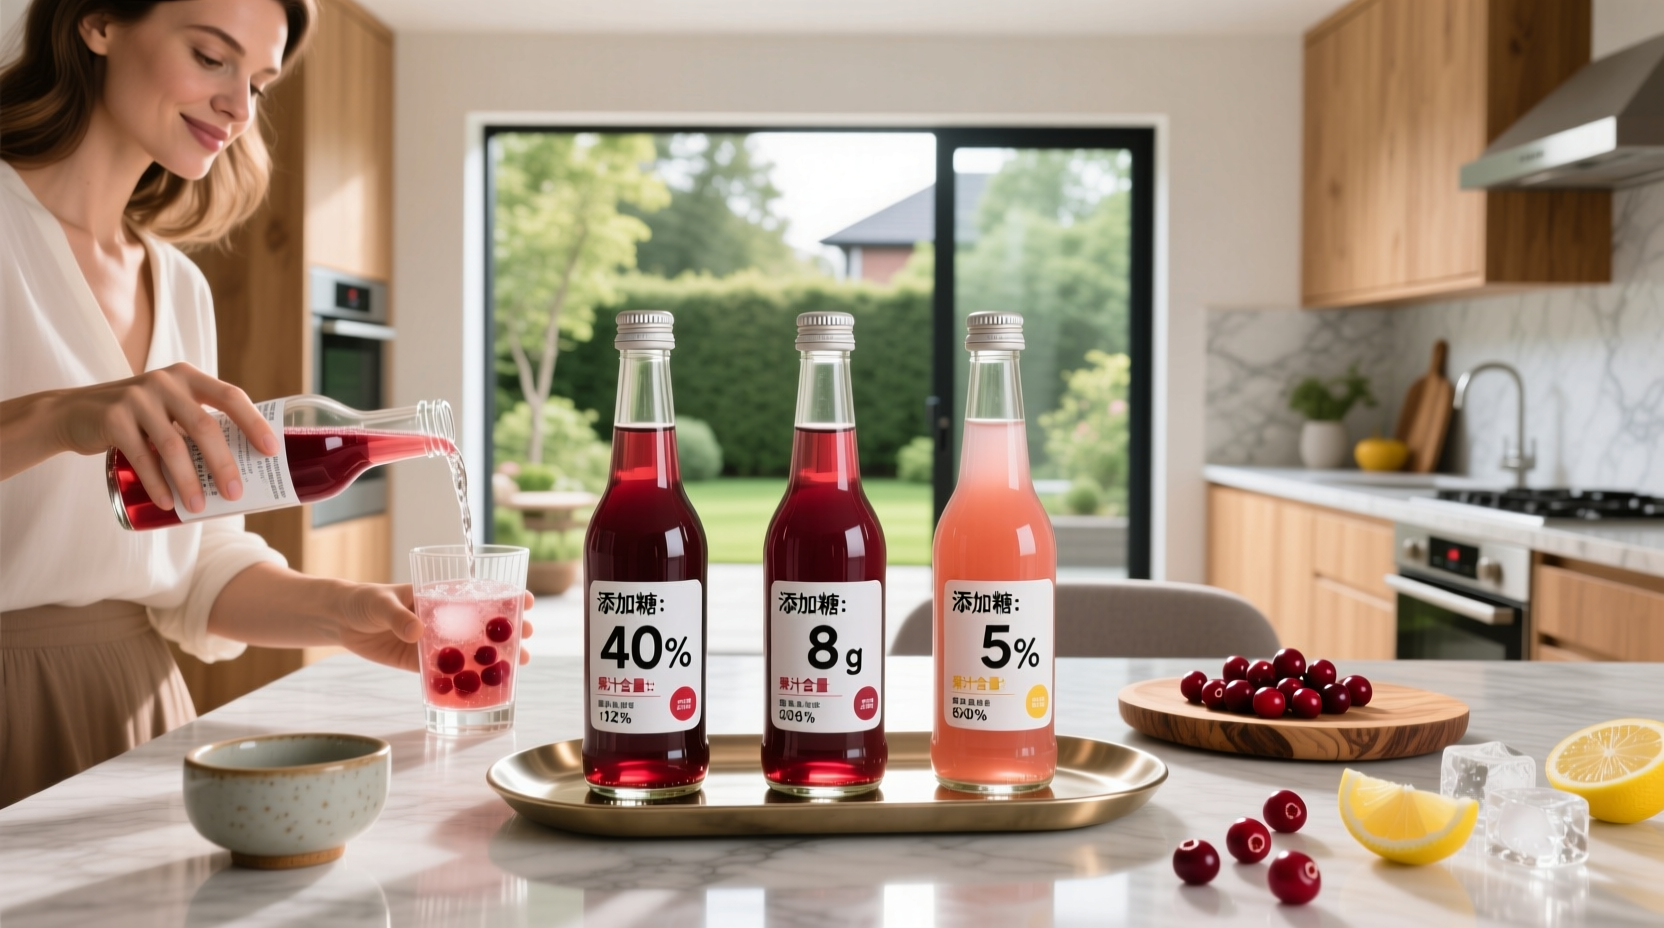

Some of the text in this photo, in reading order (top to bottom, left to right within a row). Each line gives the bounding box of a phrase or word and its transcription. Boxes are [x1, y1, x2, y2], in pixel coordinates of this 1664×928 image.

[597, 591, 664, 616] 添加糖:
[778, 591, 846, 616] 添加糖:
[952, 590, 1020, 615] 添加糖:
[600, 625, 692, 670] 40%
[808, 625, 863, 675] 8 g
[981, 625, 1040, 670] 5%
